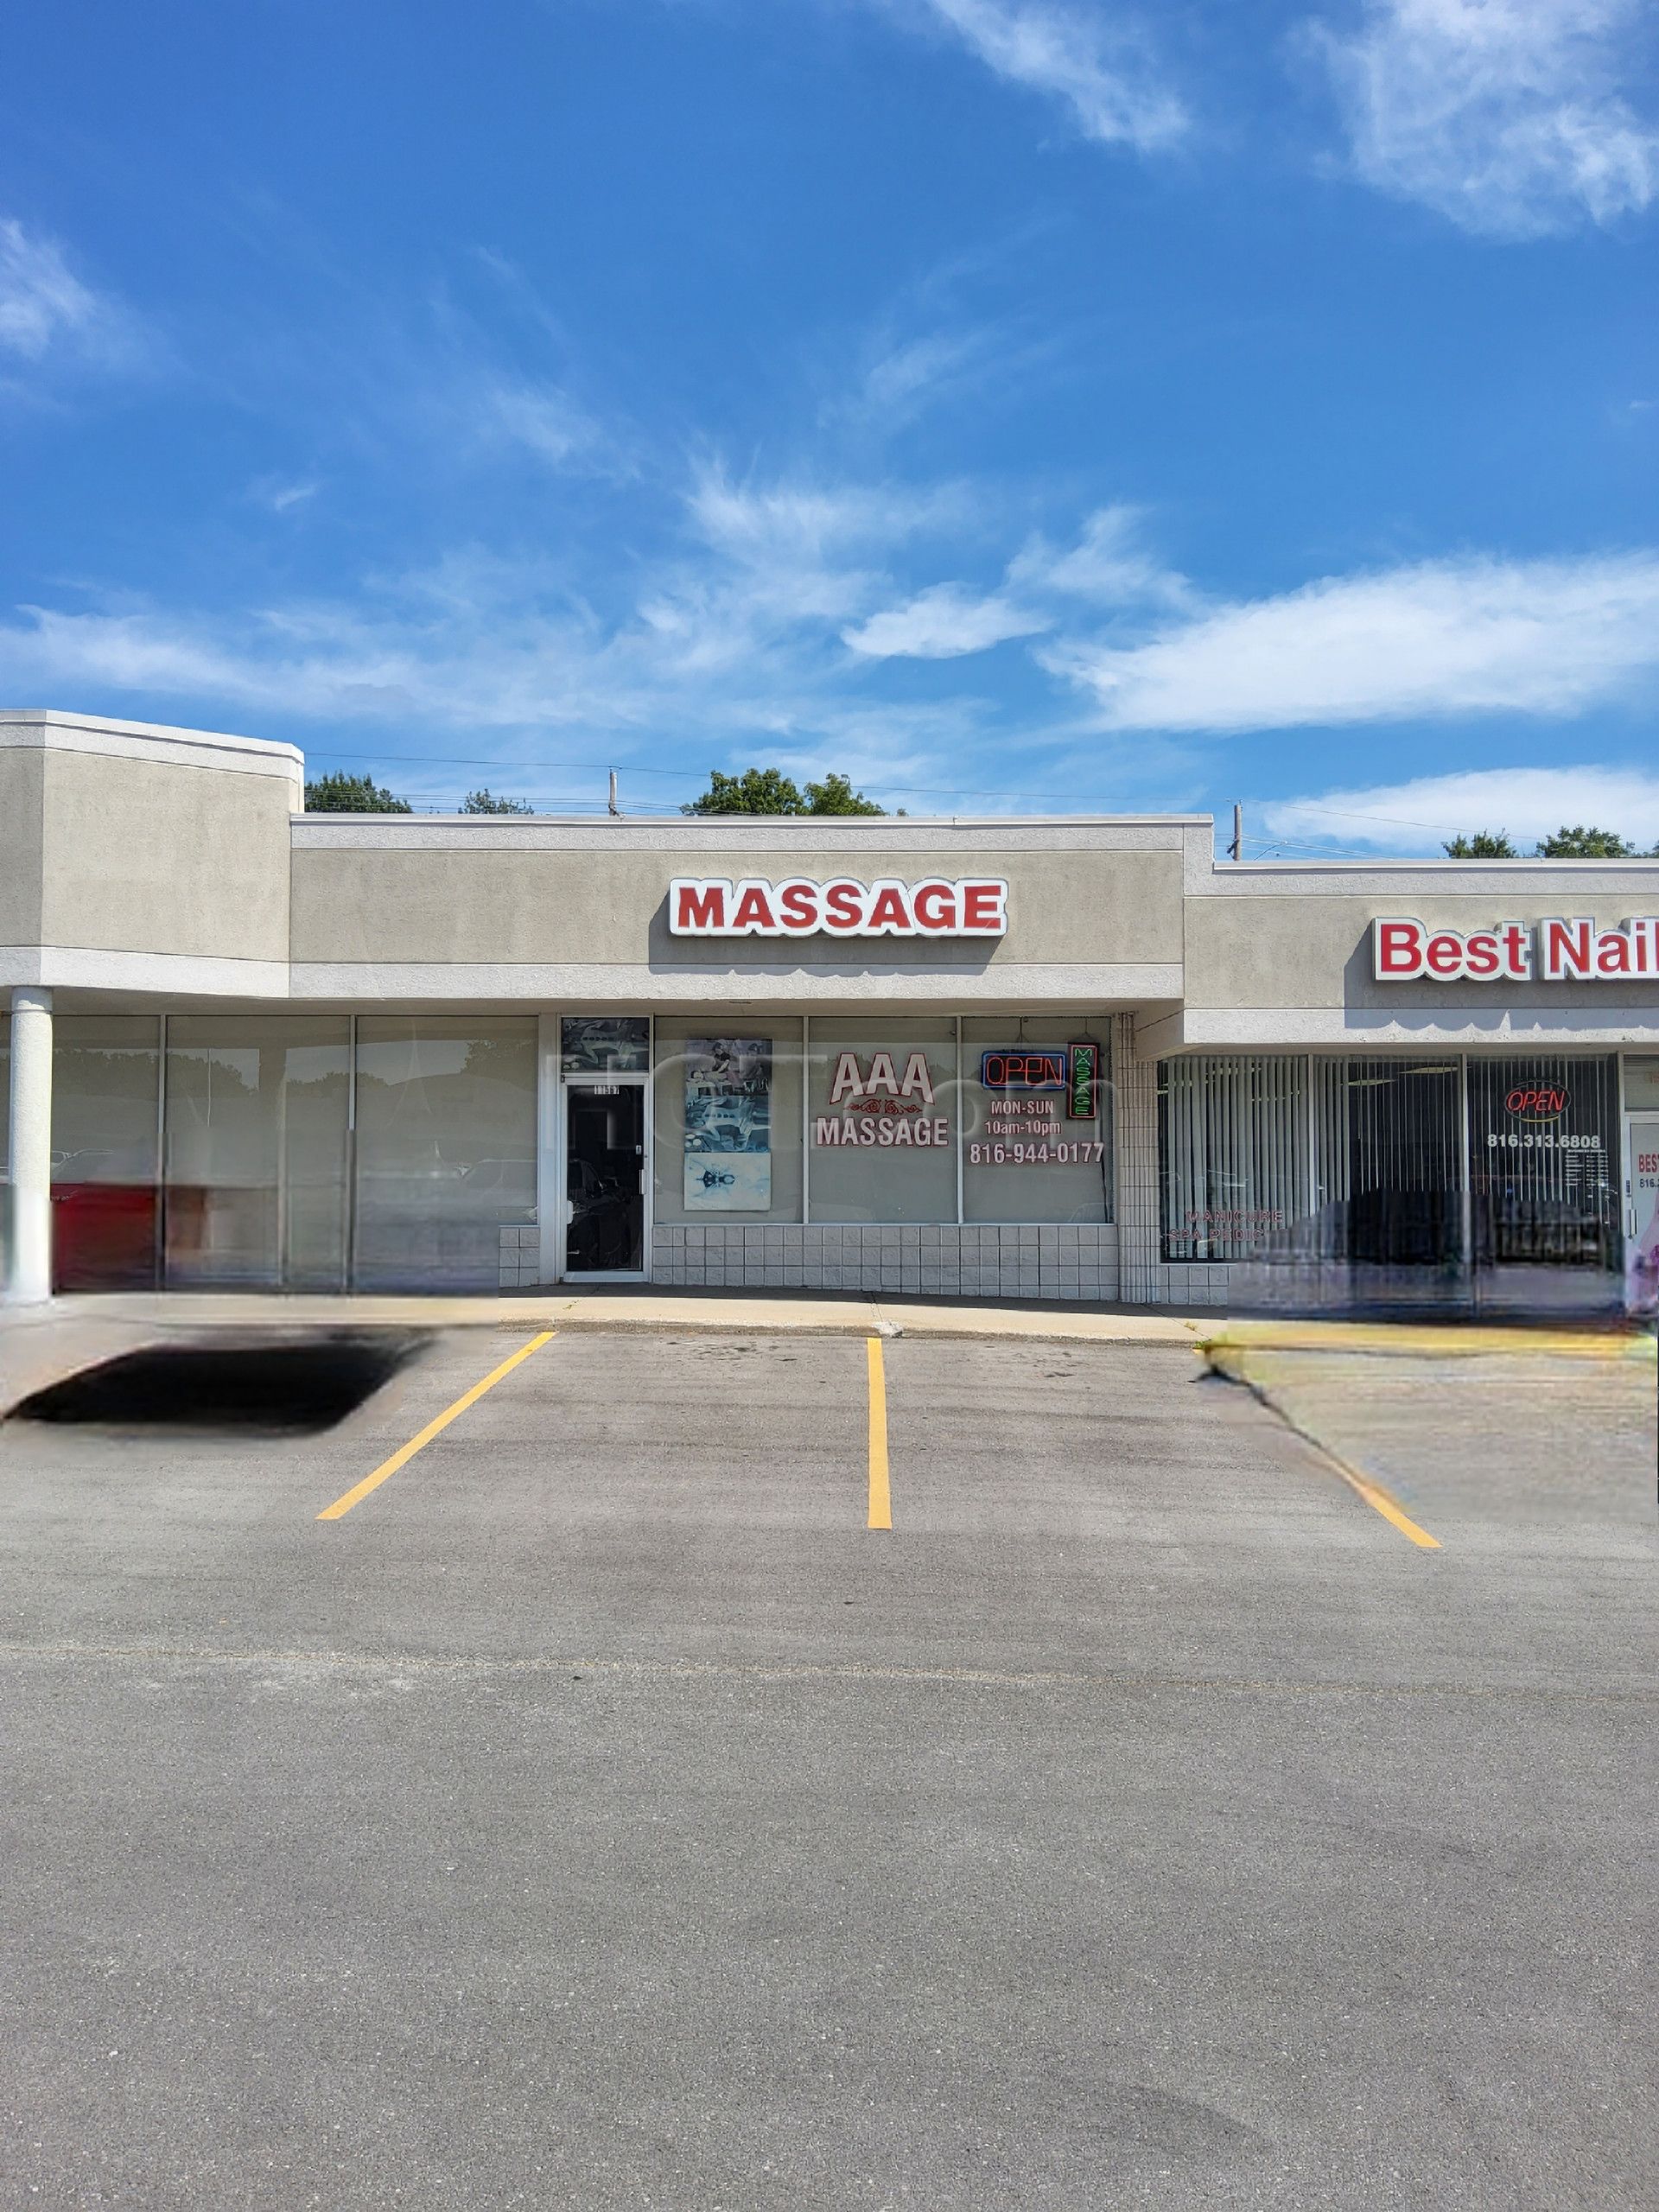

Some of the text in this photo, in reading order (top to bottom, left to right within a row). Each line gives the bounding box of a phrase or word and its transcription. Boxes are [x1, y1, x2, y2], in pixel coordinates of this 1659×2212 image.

[677, 884, 1001, 930] MASSAGE
[1381, 923, 1527, 974] Best
[829, 1052, 936, 1105] AAA
[986, 1057, 1063, 1085] OPEN
[1074, 1047, 1093, 1116] MASSAGE
[991, 1100, 1055, 1116] MON-SUN
[1507, 1090, 1566, 1112] OPEN
[815, 1116, 950, 1147] MASSAGE
[984, 1121, 1063, 1135] 10am-10pm
[1487, 1134, 1601, 1148] 816.313.6808
[969, 1142, 1104, 1165] 816-944-0177
[1185, 1210, 1284, 1224] MANICURE
[1168, 1228, 1203, 1242] SPA
